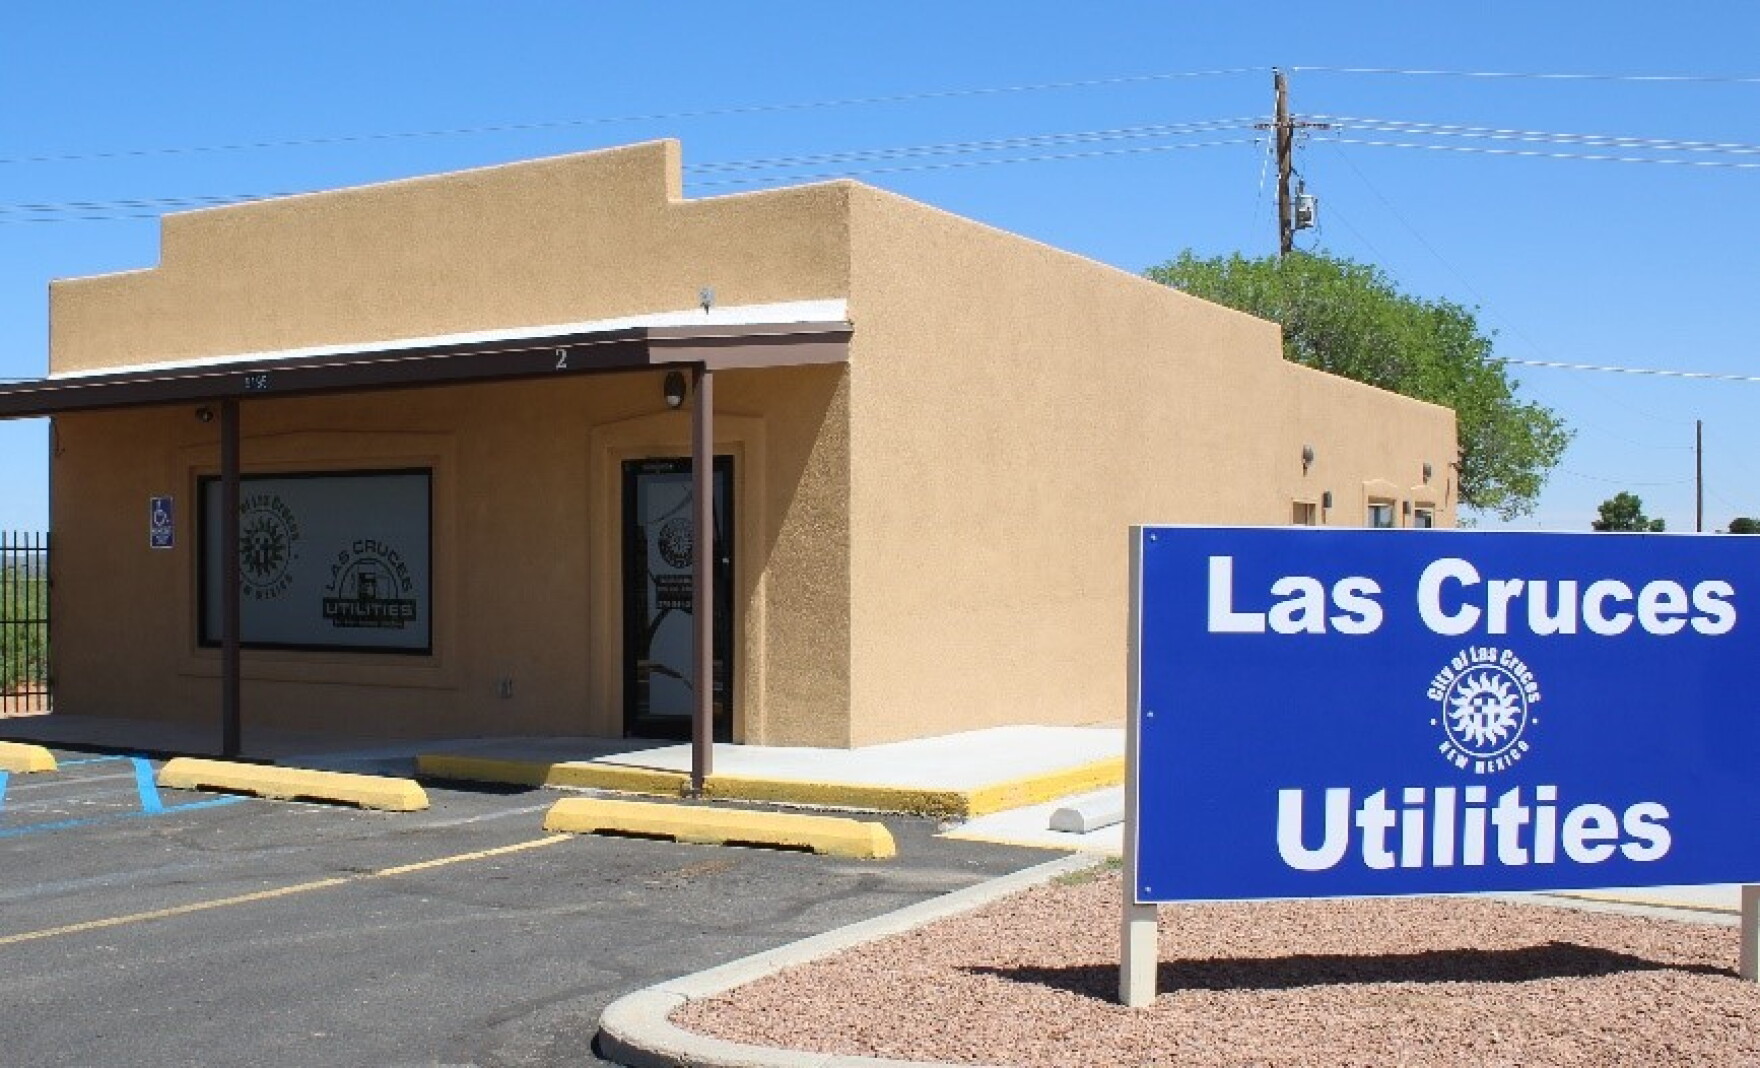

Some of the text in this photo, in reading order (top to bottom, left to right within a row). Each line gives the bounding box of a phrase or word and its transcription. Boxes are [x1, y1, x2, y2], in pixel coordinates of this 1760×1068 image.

[555, 349, 567, 369] 2
[324, 539, 413, 592] LAS CRUCES
[326, 602, 413, 616] UTILITIES
[1207, 555, 1737, 636] Las Cruces
[1426, 645, 1541, 703] City of Las Cruces
[1438, 740, 1530, 775] NEW MEXICO
[1276, 784, 1673, 872] Utilities
